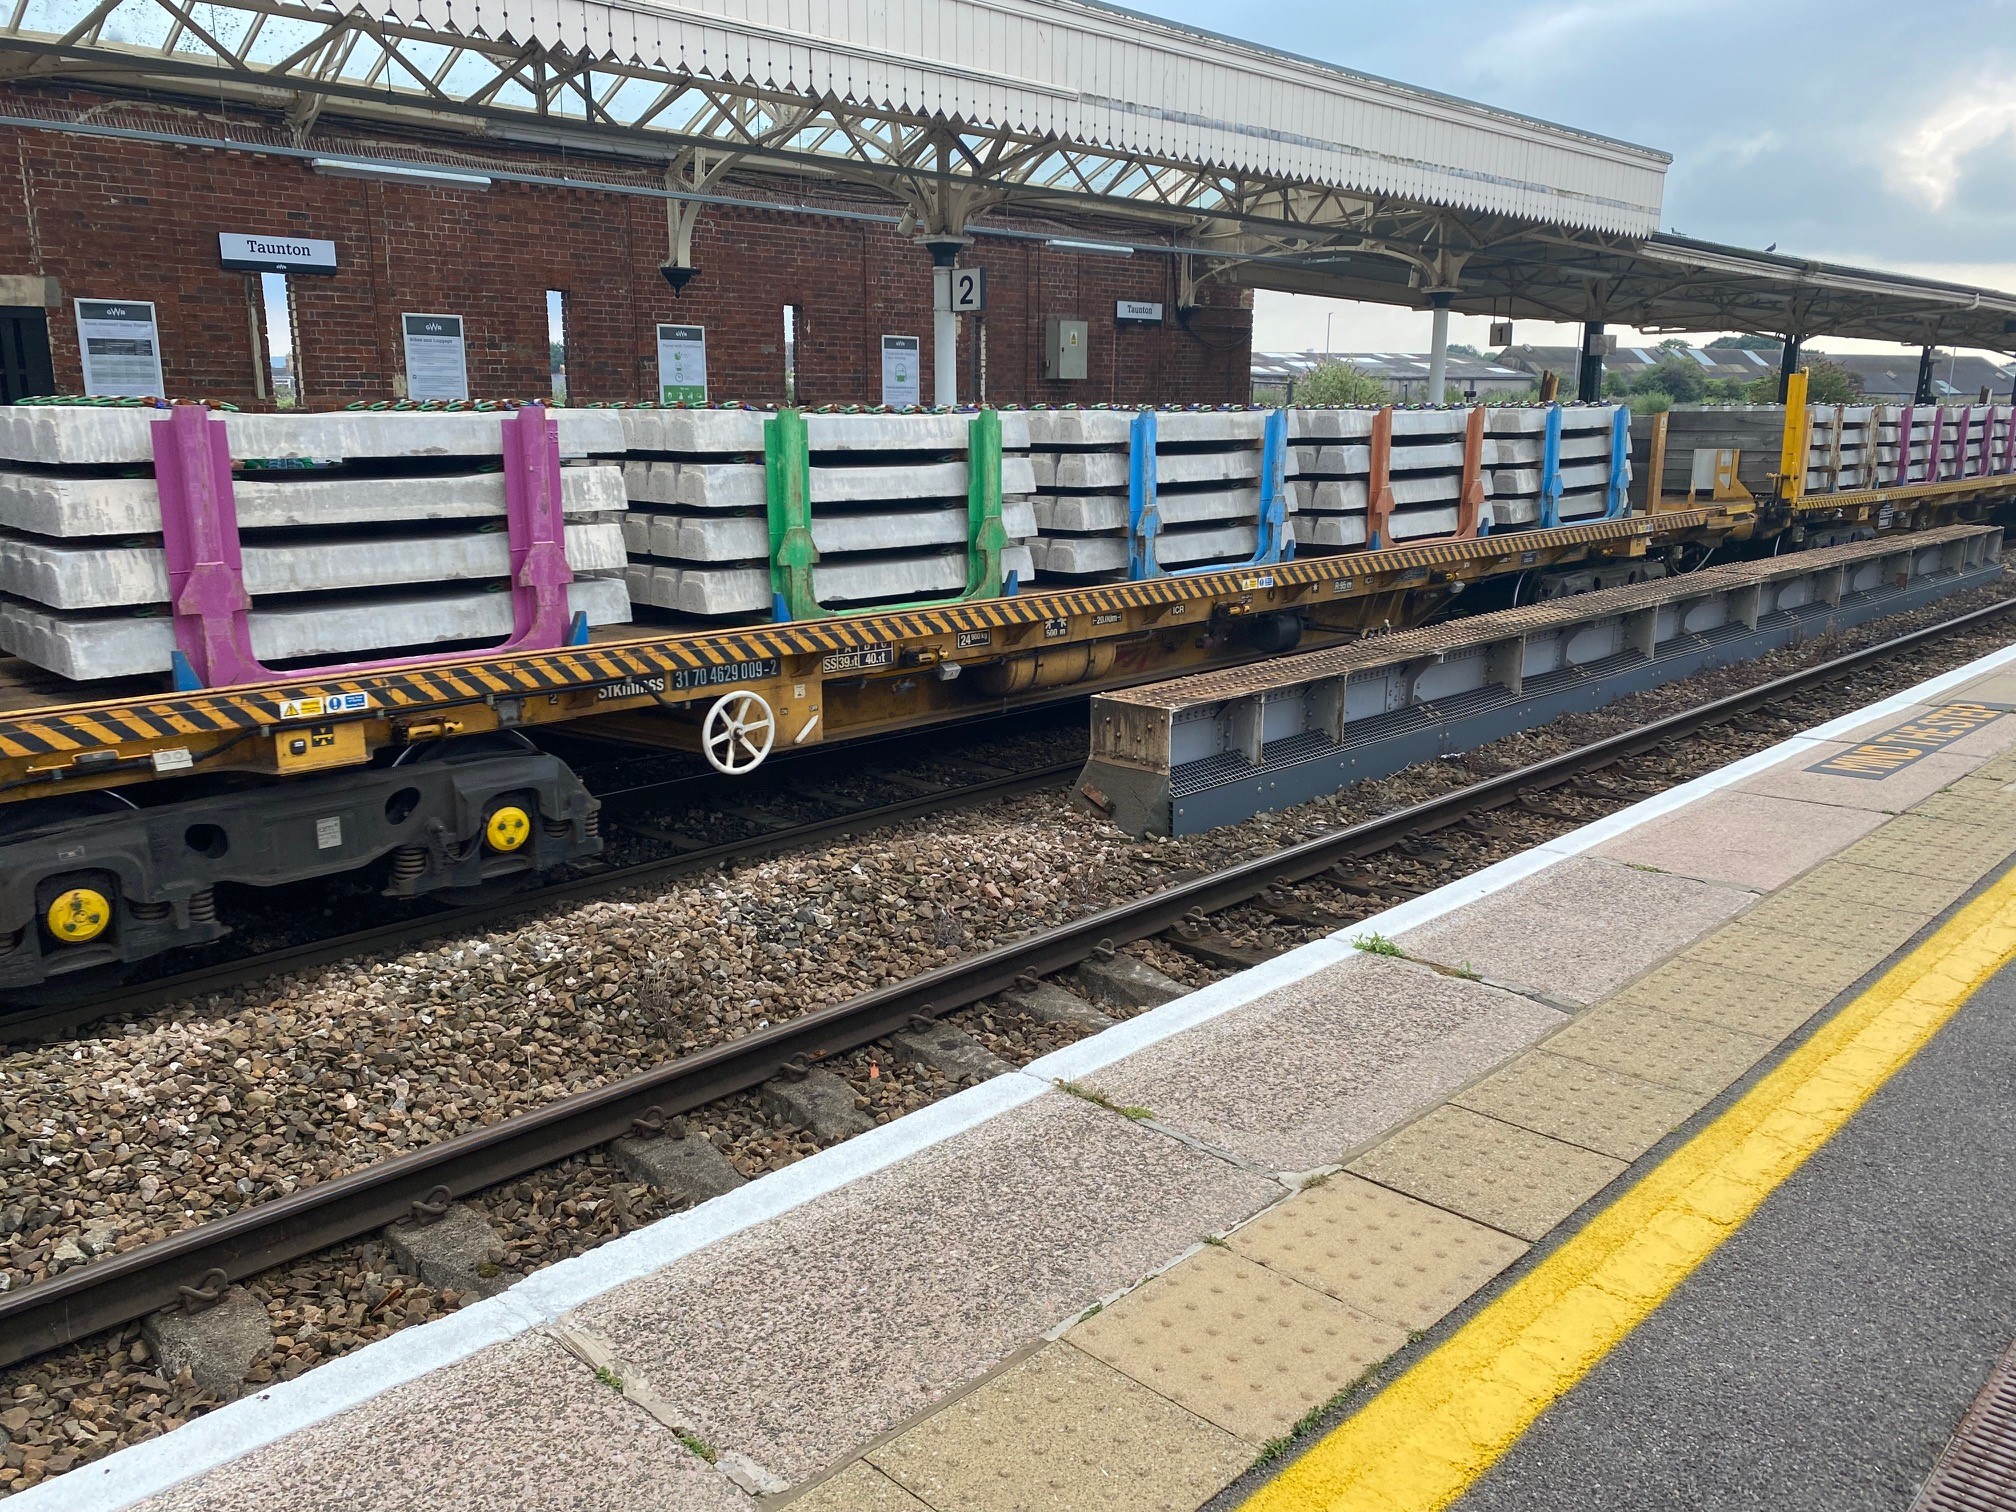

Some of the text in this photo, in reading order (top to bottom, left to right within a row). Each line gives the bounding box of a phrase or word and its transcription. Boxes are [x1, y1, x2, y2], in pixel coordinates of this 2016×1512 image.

[247, 240, 312, 256] Taunton
[959, 275, 974, 305] 2
[106, 307, 126, 316] GWR
[1127, 305, 1153, 315] Taunton
[425, 322, 442, 332] GWR
[1497, 326, 1503, 343] 1
[1172, 605, 1184, 614] ICR
[1046, 628, 1058, 637] 500
[824, 658, 837, 670] SS
[865, 652, 886, 664] 40.1t
[675, 659, 777, 688] 31 70 4629 009-2
[1820, 703, 2002, 775] MIND THE STEP
